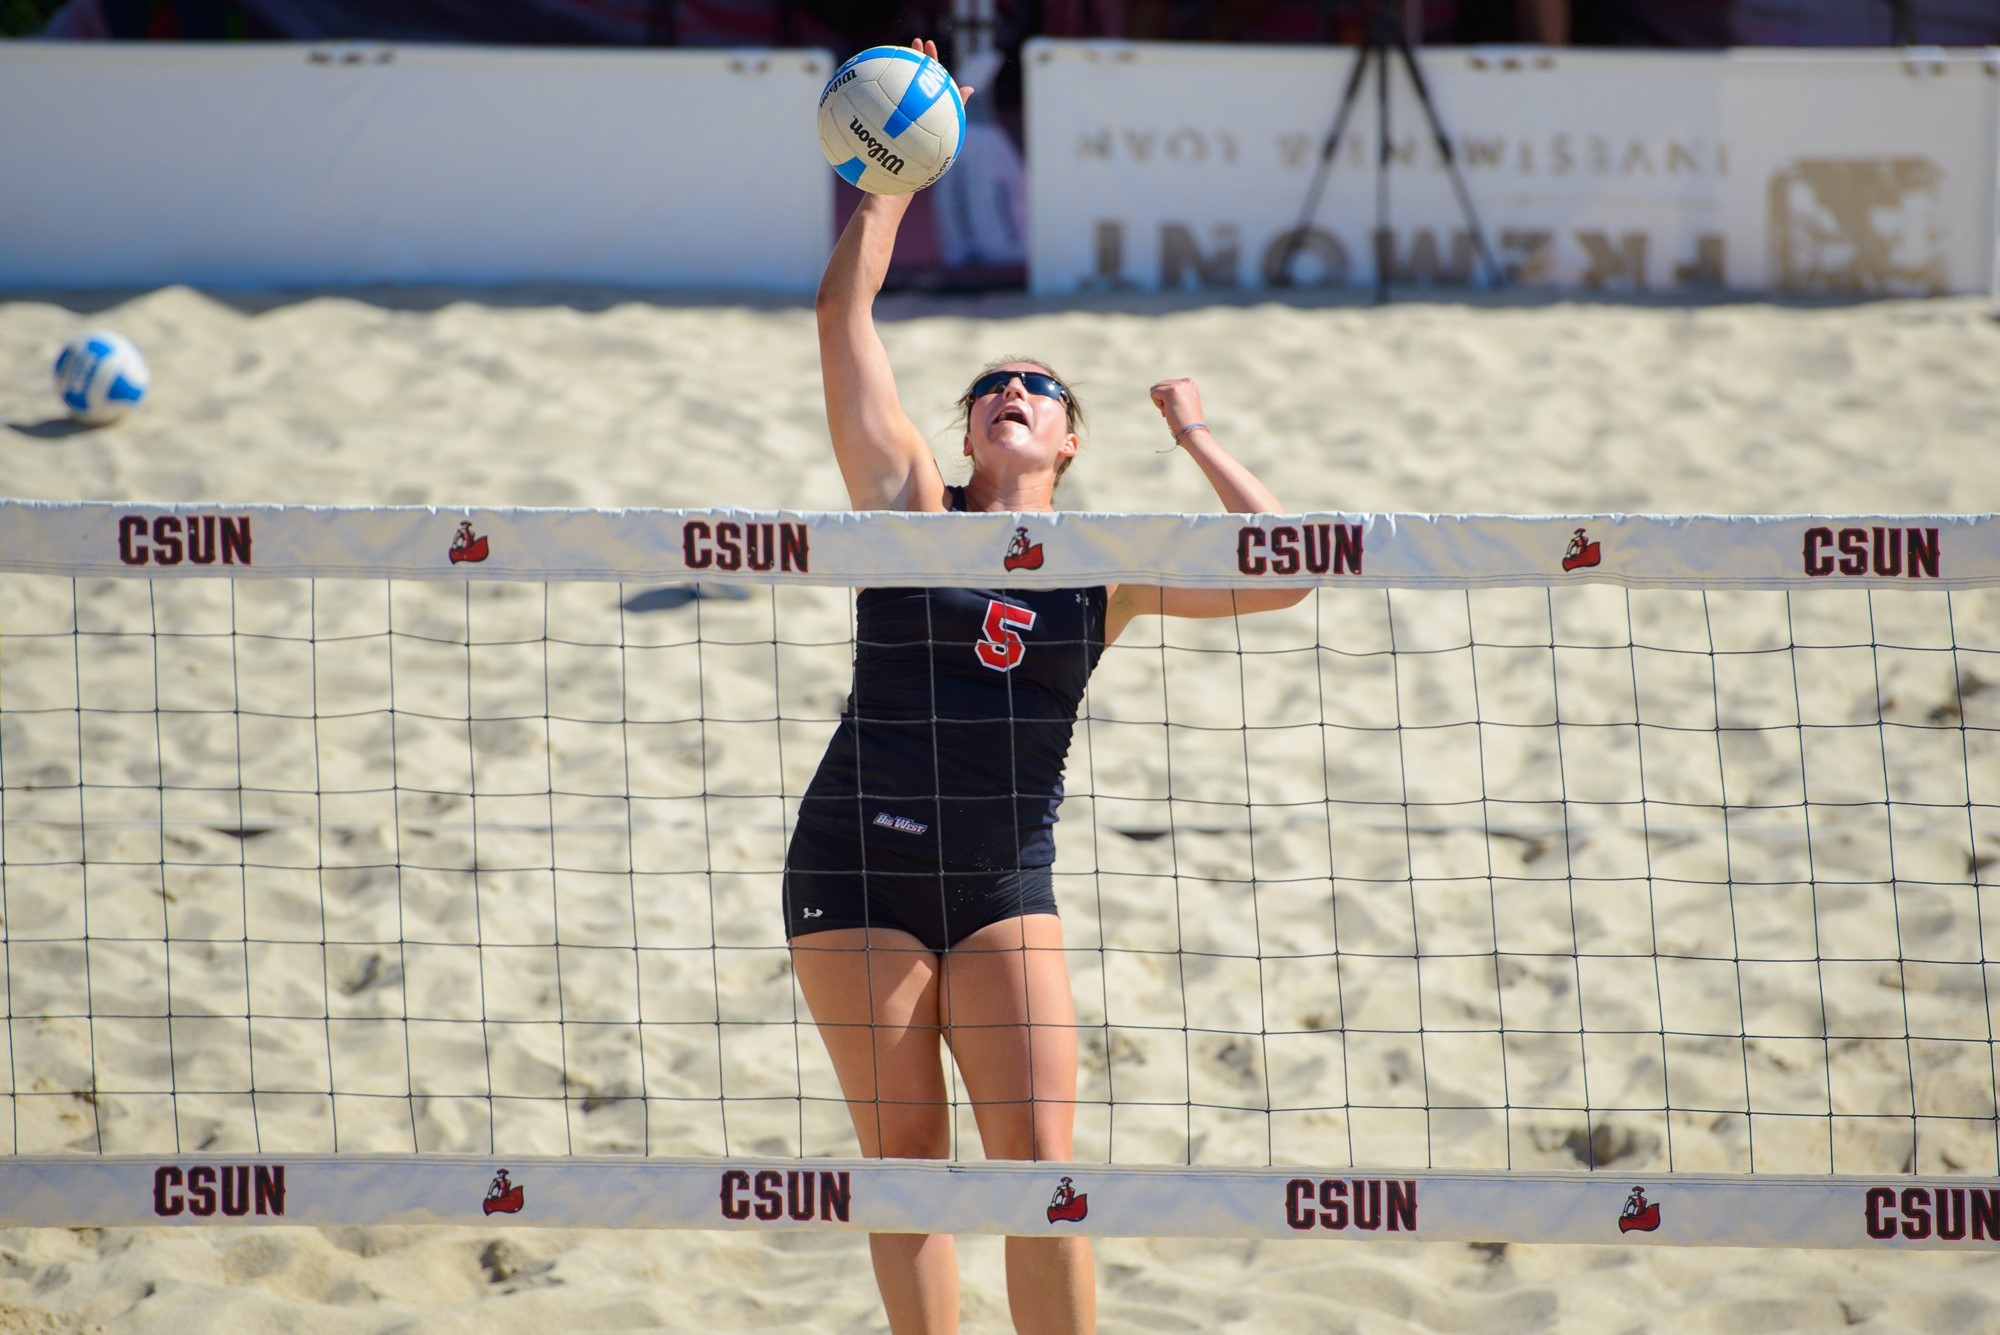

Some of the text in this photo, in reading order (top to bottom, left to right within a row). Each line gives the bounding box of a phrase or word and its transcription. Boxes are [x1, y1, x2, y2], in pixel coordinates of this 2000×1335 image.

[850, 116, 905, 176] Wilson
[118, 515, 253, 566] CSUN
[682, 521, 810, 573] CSUN
[1236, 524, 1364, 576] CSUN
[1802, 527, 1941, 578] CSUN
[974, 599, 1037, 673] 5
[153, 1165, 287, 1217] CSUN
[719, 1170, 852, 1222] CSUN
[1284, 1178, 1418, 1232] CSUN
[1864, 1187, 2000, 1241] CSUN
